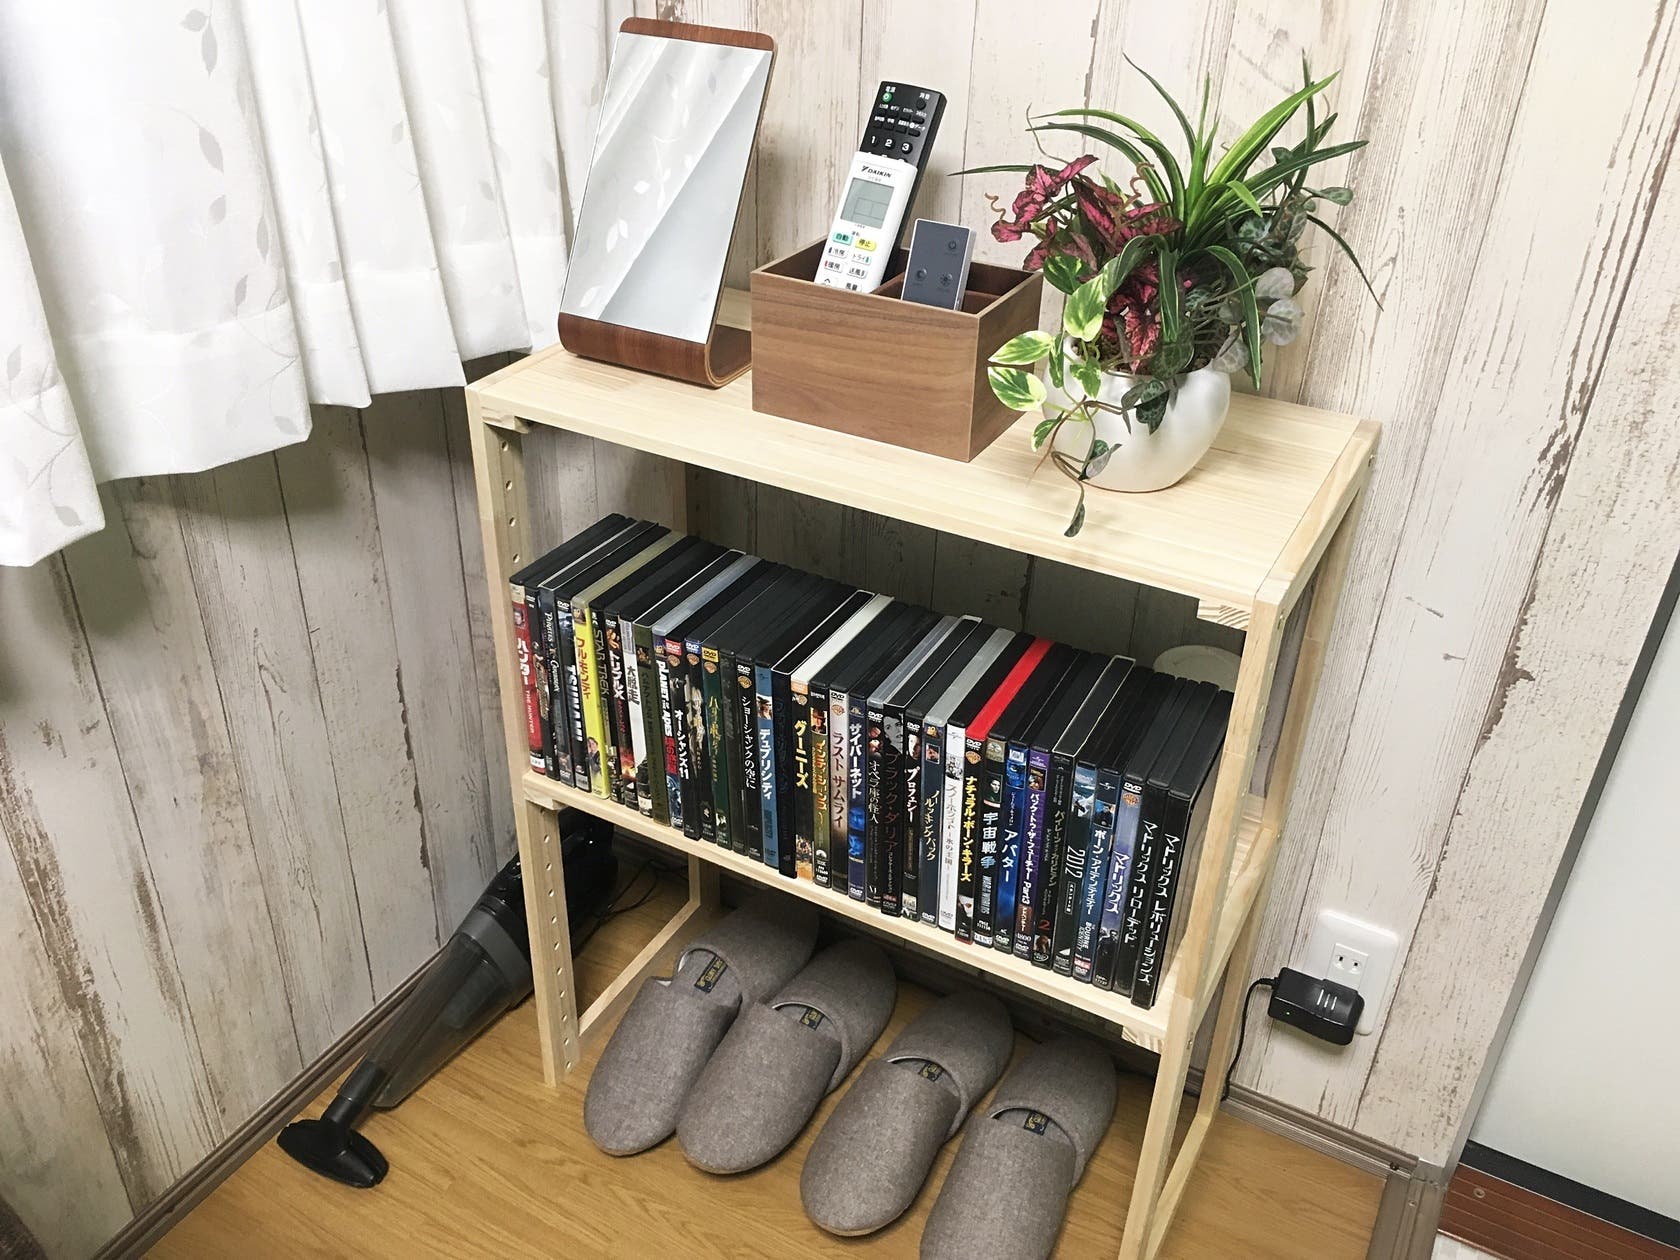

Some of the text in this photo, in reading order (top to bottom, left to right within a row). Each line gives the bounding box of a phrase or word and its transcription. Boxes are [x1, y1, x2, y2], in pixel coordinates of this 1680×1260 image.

[871, 135, 876, 144] 1
[884, 138, 893, 147] 2
[901, 142, 910, 151] 3
[867, 168, 892, 178] DAIKIN
[517, 637, 531, 685] ハンター
[594, 629, 606, 661] STAR
[566, 664, 583, 742] TSUNAMI
[598, 663, 610, 695] TREK
[656, 659, 669, 701] PLANET
[527, 705, 535, 734] HUNTER
[661, 710, 673, 736] APES
[674, 709, 689, 779] オーシャンズ11
[741, 696, 756, 789] ショーシャンクの空に
[794, 719, 809, 789] グーニーズ
[832, 731, 845, 828] ラスト サムライ
[849, 723, 862, 799] サイバーネット
[868, 760, 880, 824] オペラ座の怪人
[884, 753, 900, 852] ブラック・ダリア
[904, 765, 921, 822] プロフェシー
[1123, 781, 1143, 791] DVD
[980, 812, 999, 869] 宇宙戦争
[1001, 828, 1018, 882] アバター
[1064, 845, 1086, 878] 2012
[1155, 833, 1180, 898] マトリックス
[1086, 830, 1107, 915] ボーン・アイデンティティー
[1104, 851, 1130, 914] マトリックス
[1124, 819, 1158, 944] マトリックス リローデッド
[1038, 919, 1050, 930] 2
[1082, 921, 1092, 949] BOURNE
